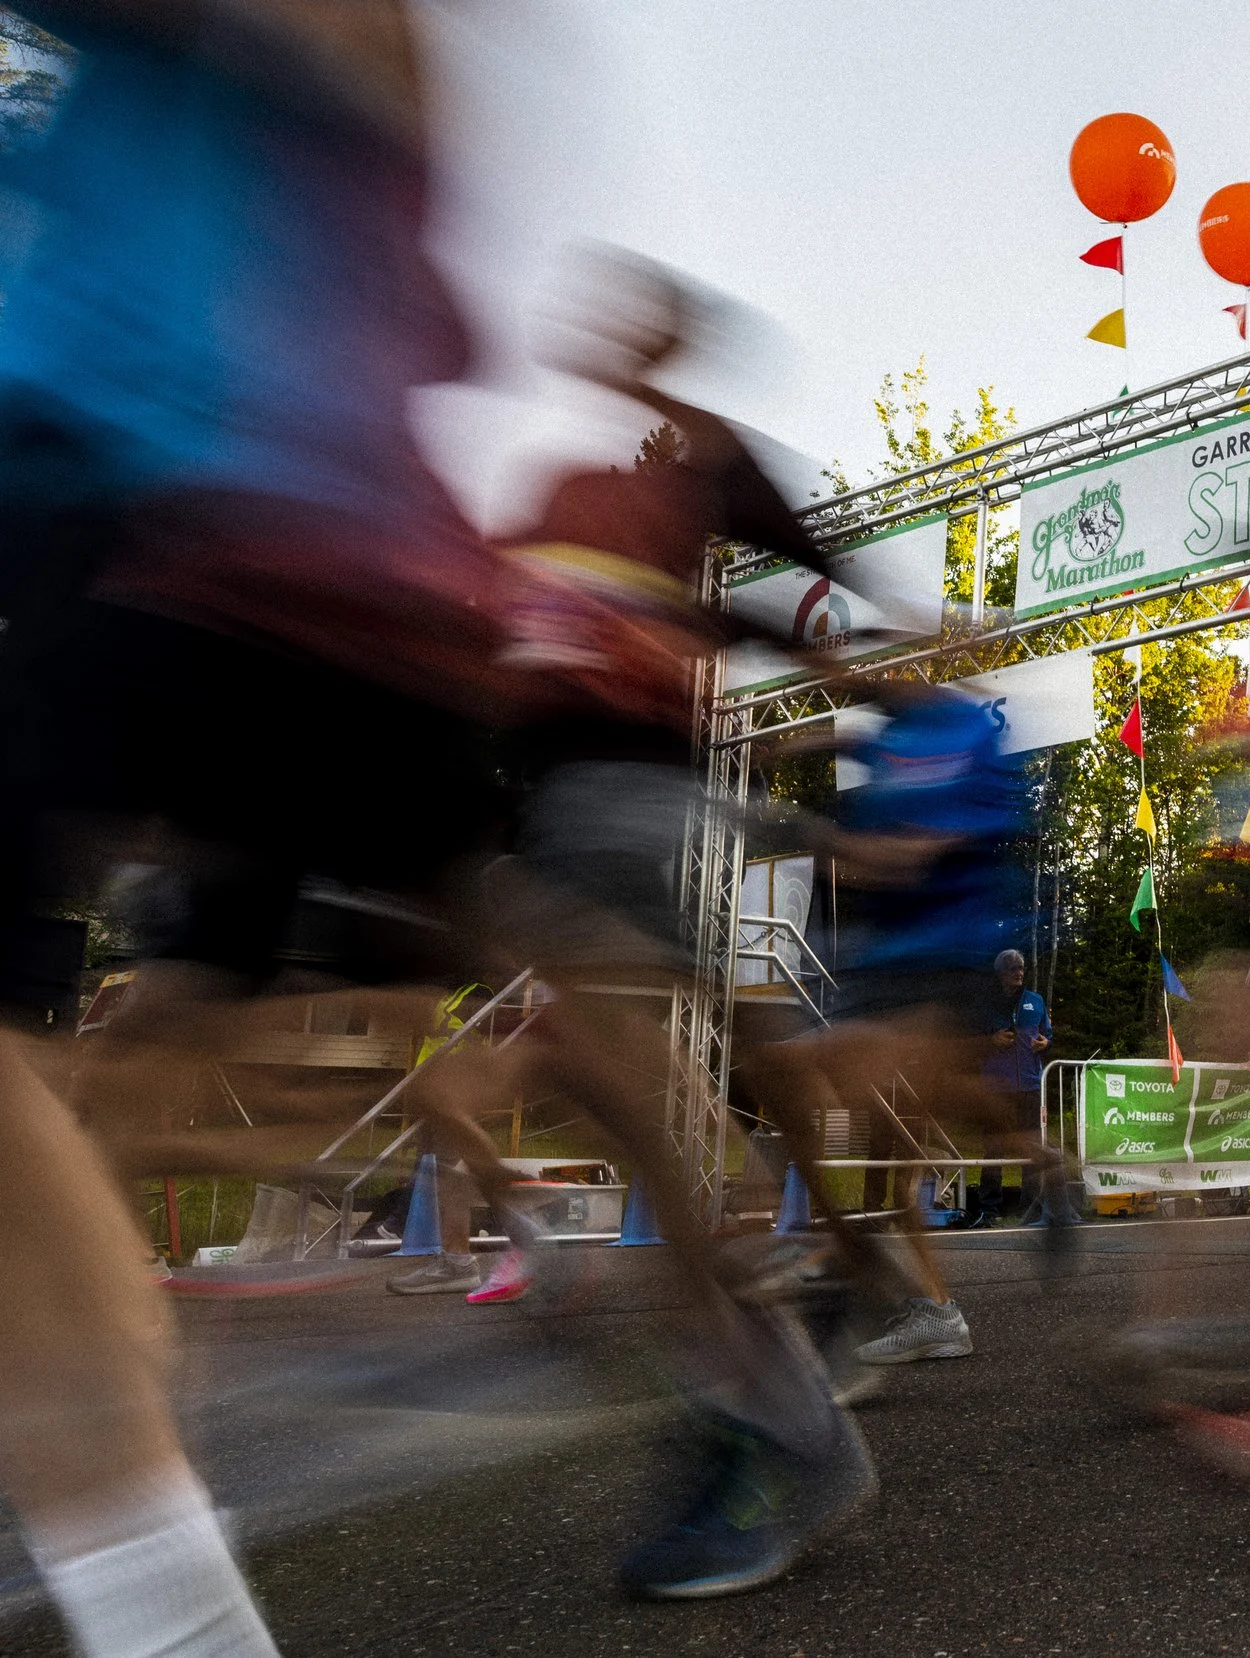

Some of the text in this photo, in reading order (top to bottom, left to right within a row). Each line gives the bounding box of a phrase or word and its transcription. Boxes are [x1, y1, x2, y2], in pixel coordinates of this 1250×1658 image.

[1045, 548, 1145, 593] Marathon
[1129, 1080, 1175, 1093] TOYOTA
[1127, 1111, 1175, 1122] MEMBERS
